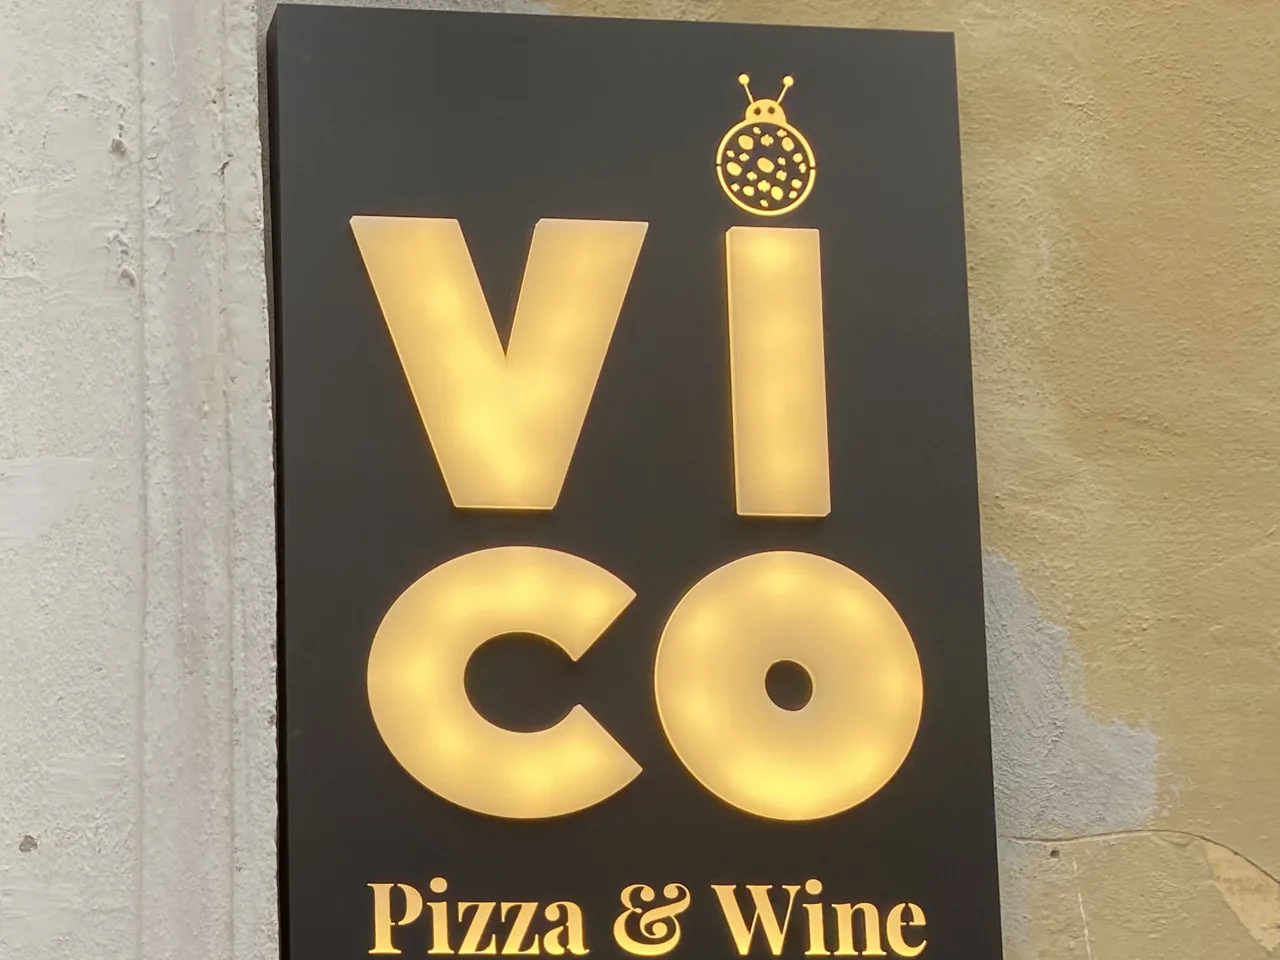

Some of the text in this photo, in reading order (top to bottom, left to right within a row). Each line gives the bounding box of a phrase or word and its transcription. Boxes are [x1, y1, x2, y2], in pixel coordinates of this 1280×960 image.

[367, 876, 928, 959] Pizza & Wine
